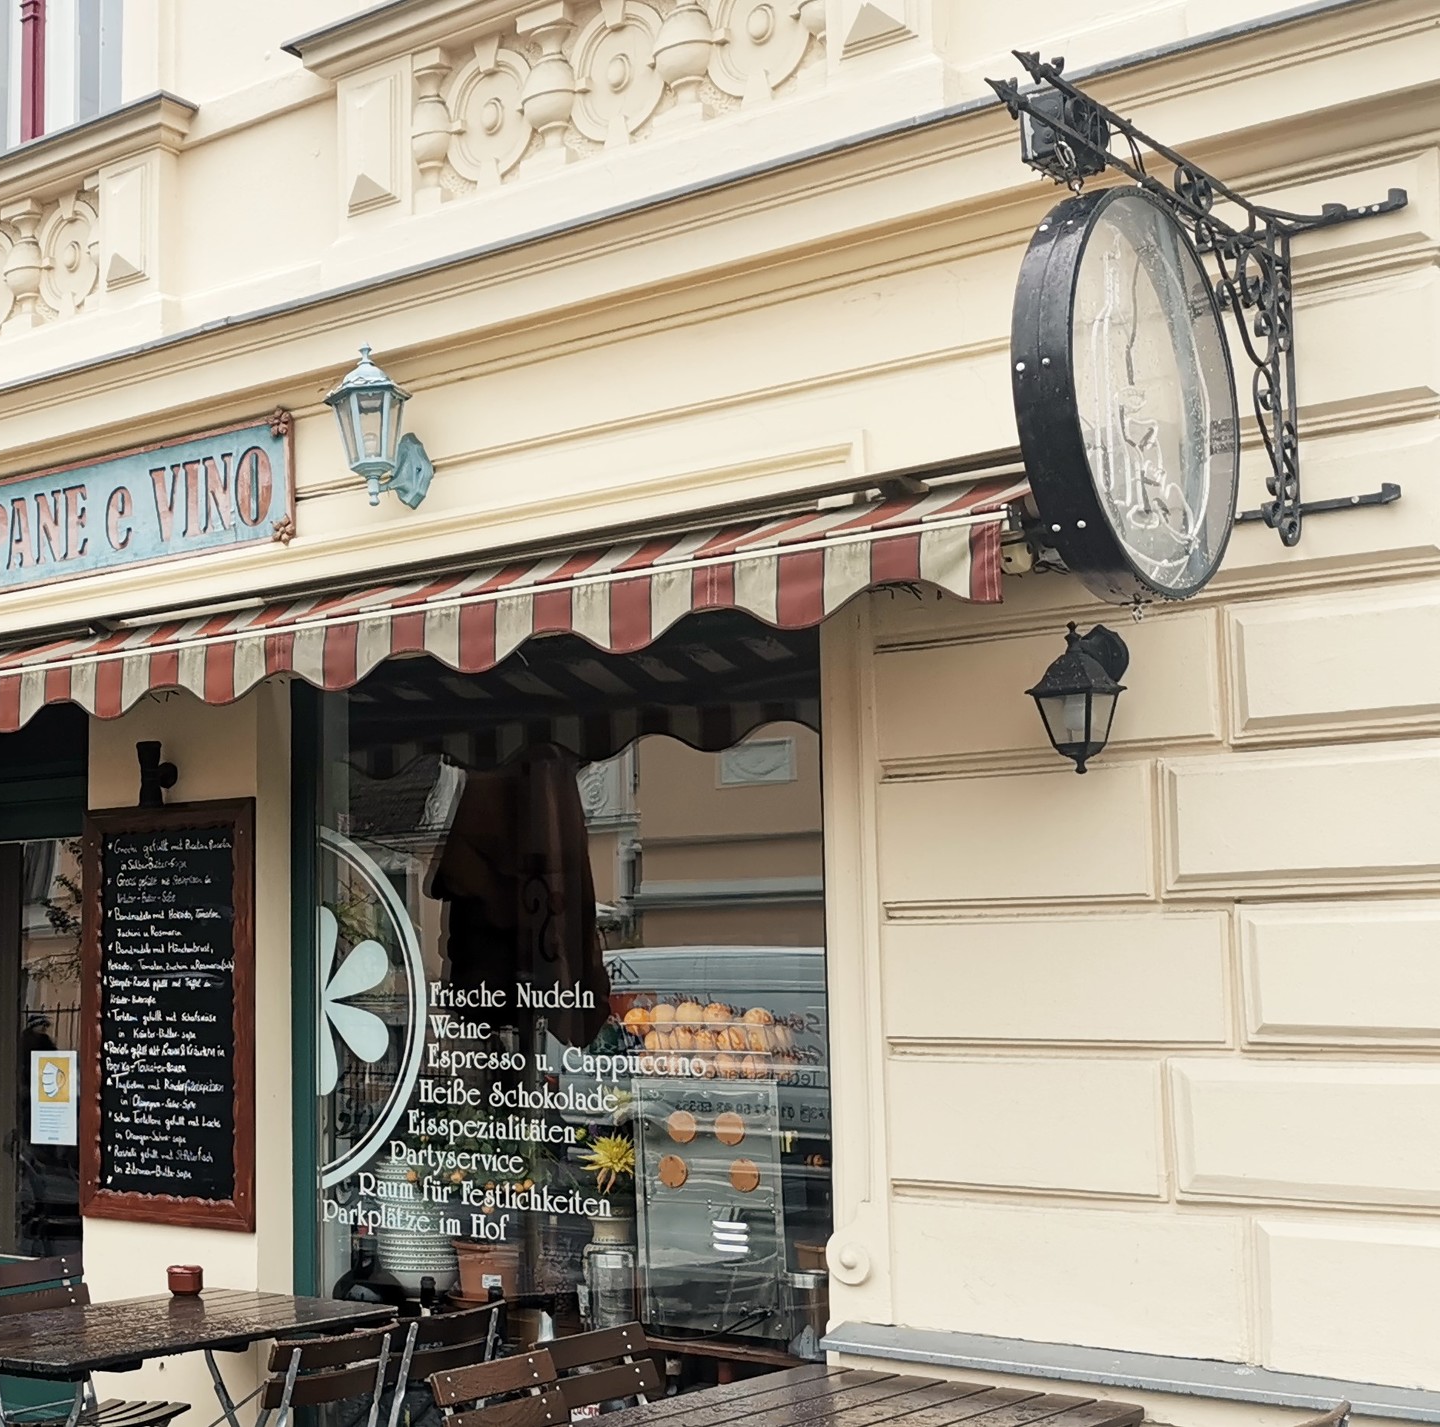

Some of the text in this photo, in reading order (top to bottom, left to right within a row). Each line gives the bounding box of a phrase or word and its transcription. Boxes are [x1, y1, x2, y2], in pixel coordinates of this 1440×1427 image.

[106, 486, 132, 551] e
[149, 446, 273, 542] VINO
[171, 838, 183, 850] mit
[153, 910, 164, 919] mit
[150, 925, 182, 936] Rosmarin
[153, 944, 164, 953] mit
[429, 980, 595, 1009] Frische Nudeln
[166, 1012, 177, 1022] mit
[118, 1028, 125, 1038] in
[428, 1015, 491, 1040] Weine
[427, 1044, 707, 1083] Espresso u. Cappuccino
[148, 1079, 160, 1090] mit
[419, 1078, 620, 1113] Heiße Schokolade
[188, 1116, 199, 1126] mit
[407, 1109, 577, 1145] Eisspezialitäten
[115, 1129, 122, 1139] in
[161, 1149, 173, 1160] mit
[390, 1141, 524, 1175] Partyservice
[114, 1161, 122, 1173] in
[358, 1171, 612, 1217] Raum für Festlichkeiten
[322, 1200, 510, 1241] Parkplätze im Hof
